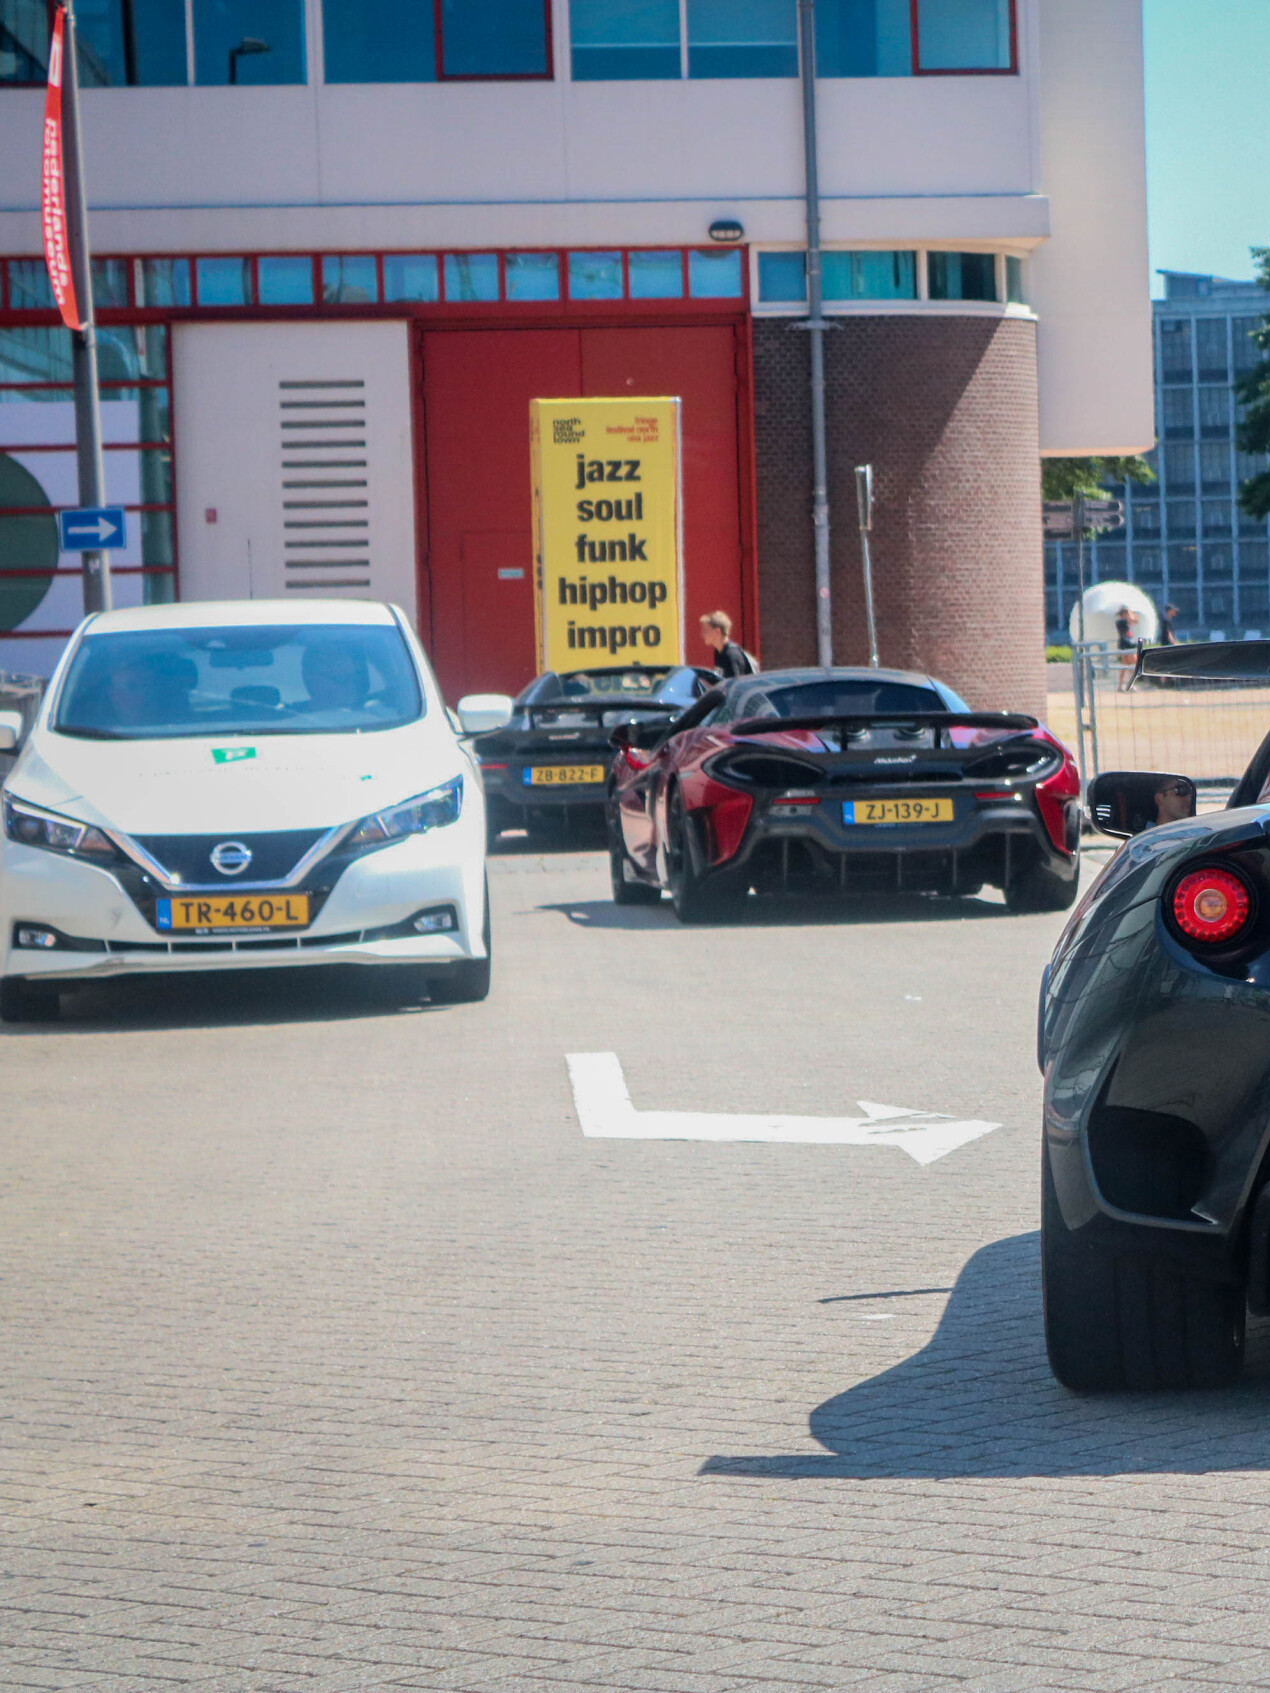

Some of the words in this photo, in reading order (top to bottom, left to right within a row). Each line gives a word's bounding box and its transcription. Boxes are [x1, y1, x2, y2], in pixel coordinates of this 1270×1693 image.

[43, 117, 66, 306] fotomuseum
[49, 119, 69, 287] nederlands
[553, 417, 582, 426] north
[553, 429, 586, 438] round
[553, 436, 580, 444] town
[576, 453, 642, 490] jazz
[576, 491, 643, 523] soul
[575, 532, 648, 564] funk
[558, 575, 668, 612] hiphop
[567, 620, 662, 655] impro
[535, 768, 598, 783] ZB-822-F
[865, 802, 940, 820] ZJ-139-J
[179, 900, 299, 924] TR-460-L
